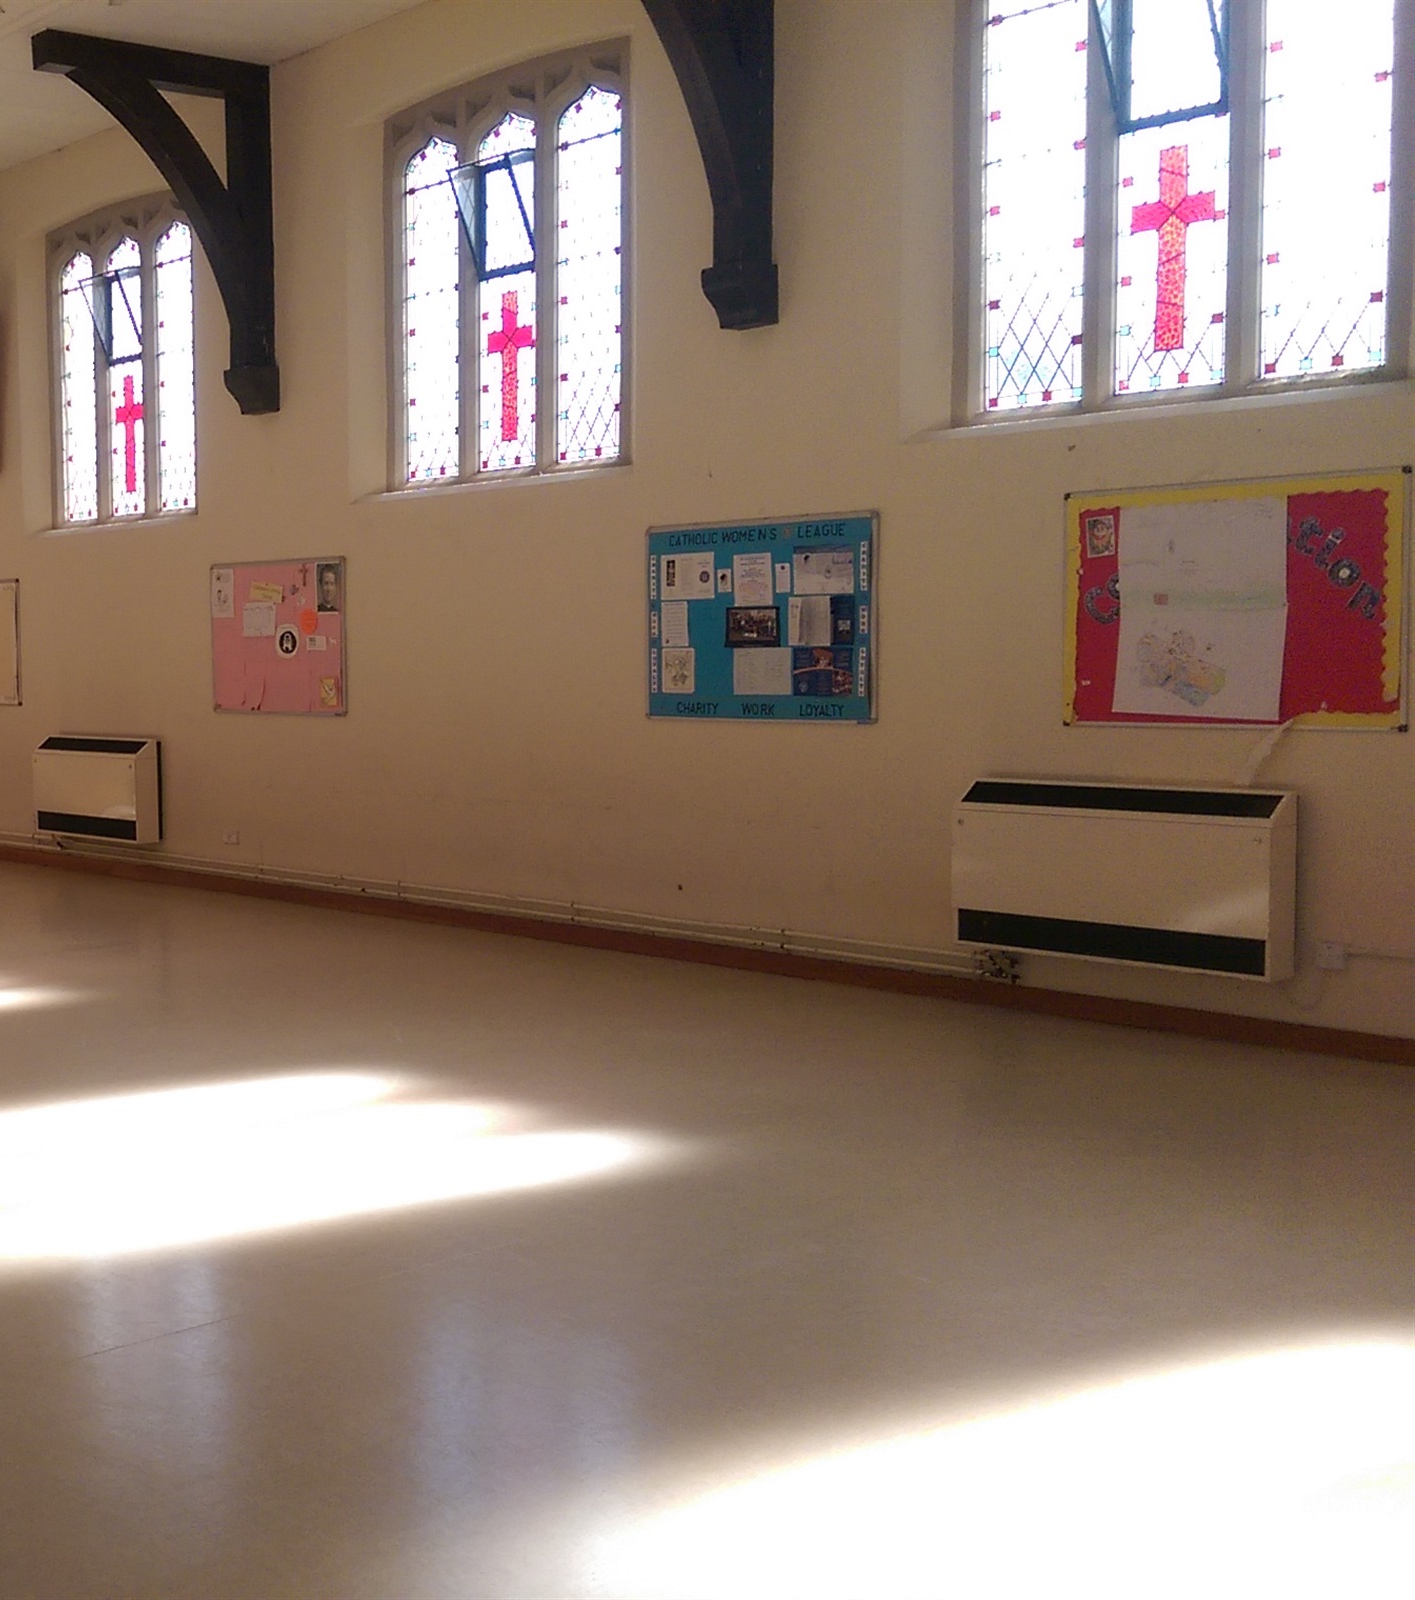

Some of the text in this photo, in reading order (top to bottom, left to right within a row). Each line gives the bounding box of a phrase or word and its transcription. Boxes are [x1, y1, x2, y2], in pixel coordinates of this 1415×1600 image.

[668, 532, 718, 547] CATHOLIC
[797, 523, 846, 538] LEAGUE
[676, 701, 844, 717] CHARITY WORK LOYALTY
